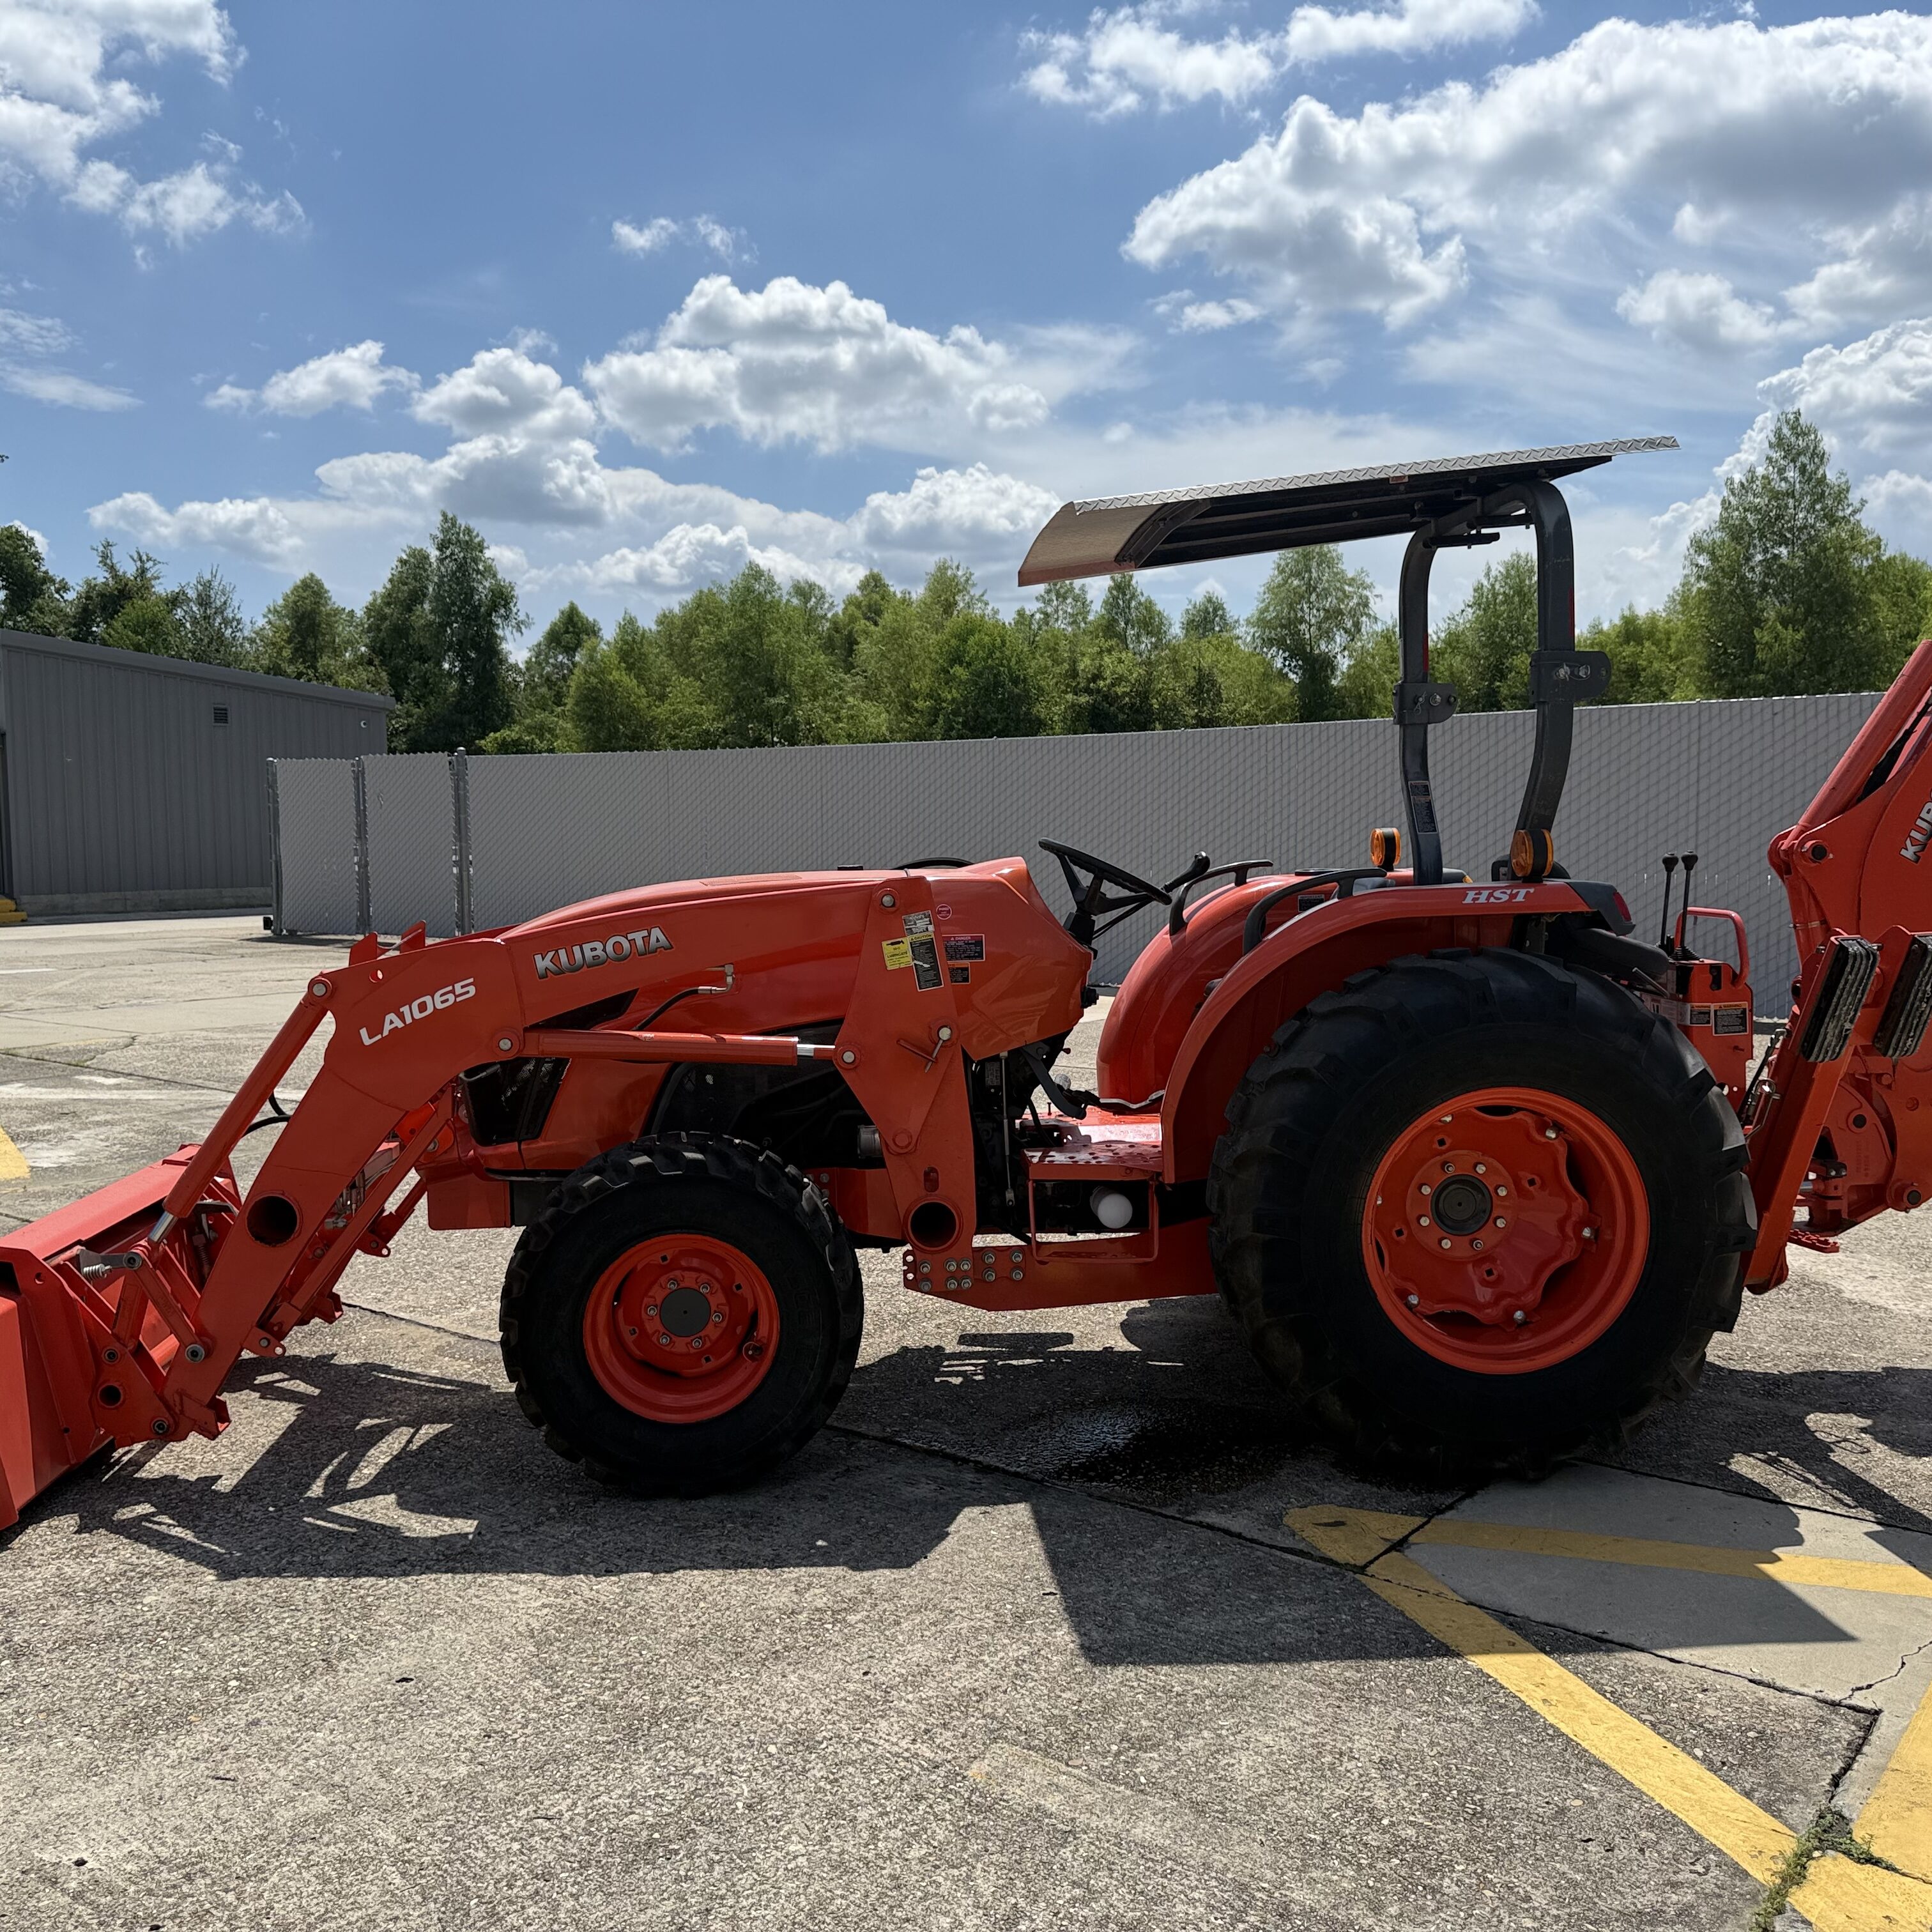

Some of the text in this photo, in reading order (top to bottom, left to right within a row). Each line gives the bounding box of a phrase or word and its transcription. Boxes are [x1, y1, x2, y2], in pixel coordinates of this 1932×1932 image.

[1899, 788, 1932, 864] KUB
[1462, 888, 1535, 904] HST
[533, 926, 673, 979] KUBOTA
[359, 977, 476, 1046] LA1065
